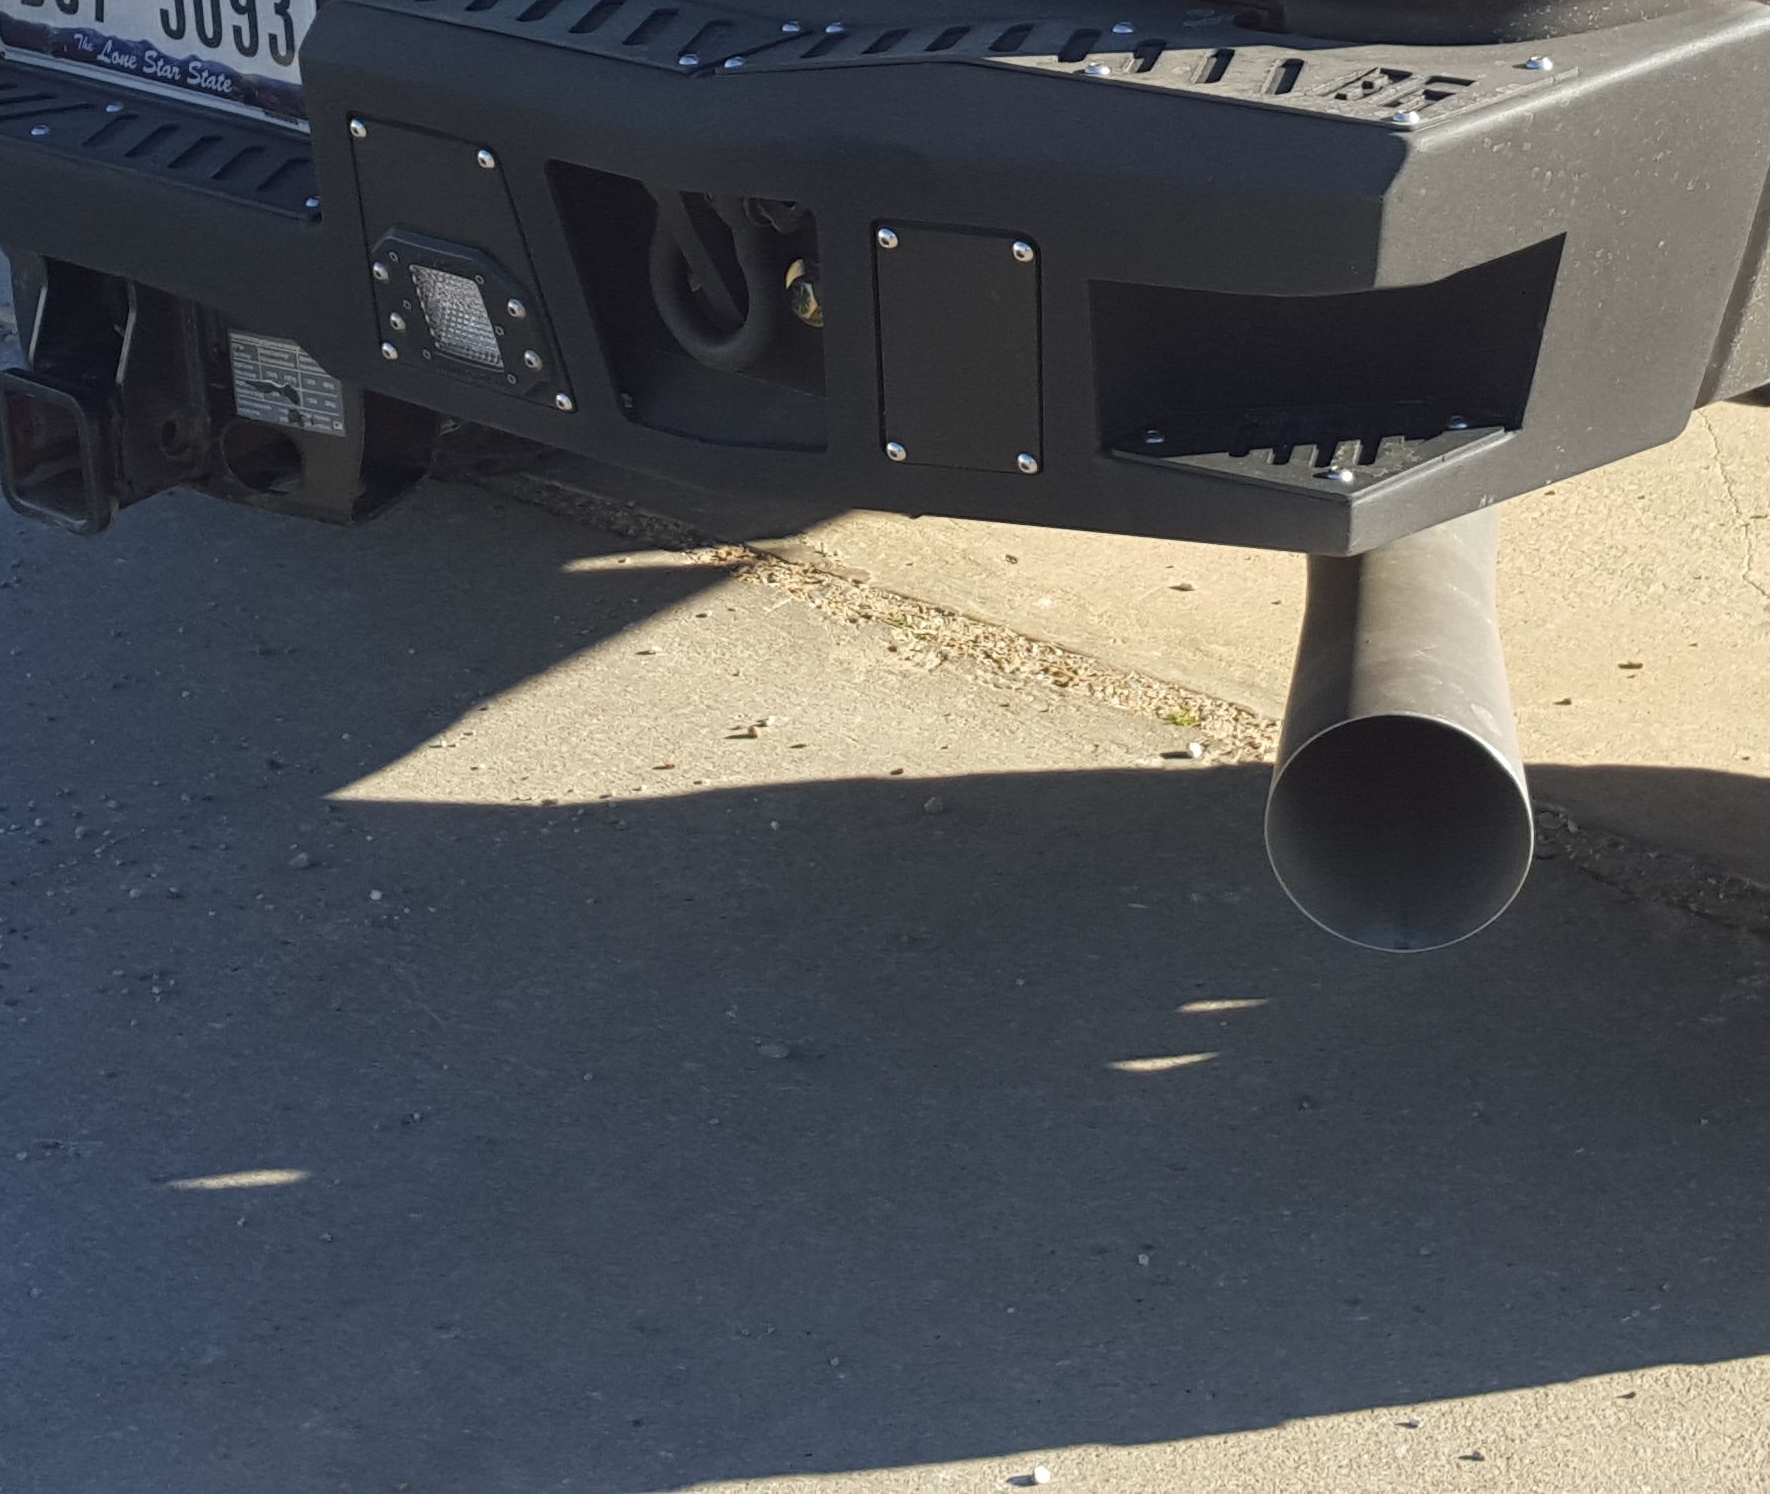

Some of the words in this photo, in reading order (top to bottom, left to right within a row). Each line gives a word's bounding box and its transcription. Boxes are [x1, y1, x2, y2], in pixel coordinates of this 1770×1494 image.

[74, 33, 94, 54] The
[97, 41, 138, 72] Lone
[142, 50, 182, 82] Star
[186, 63, 233, 93] State
